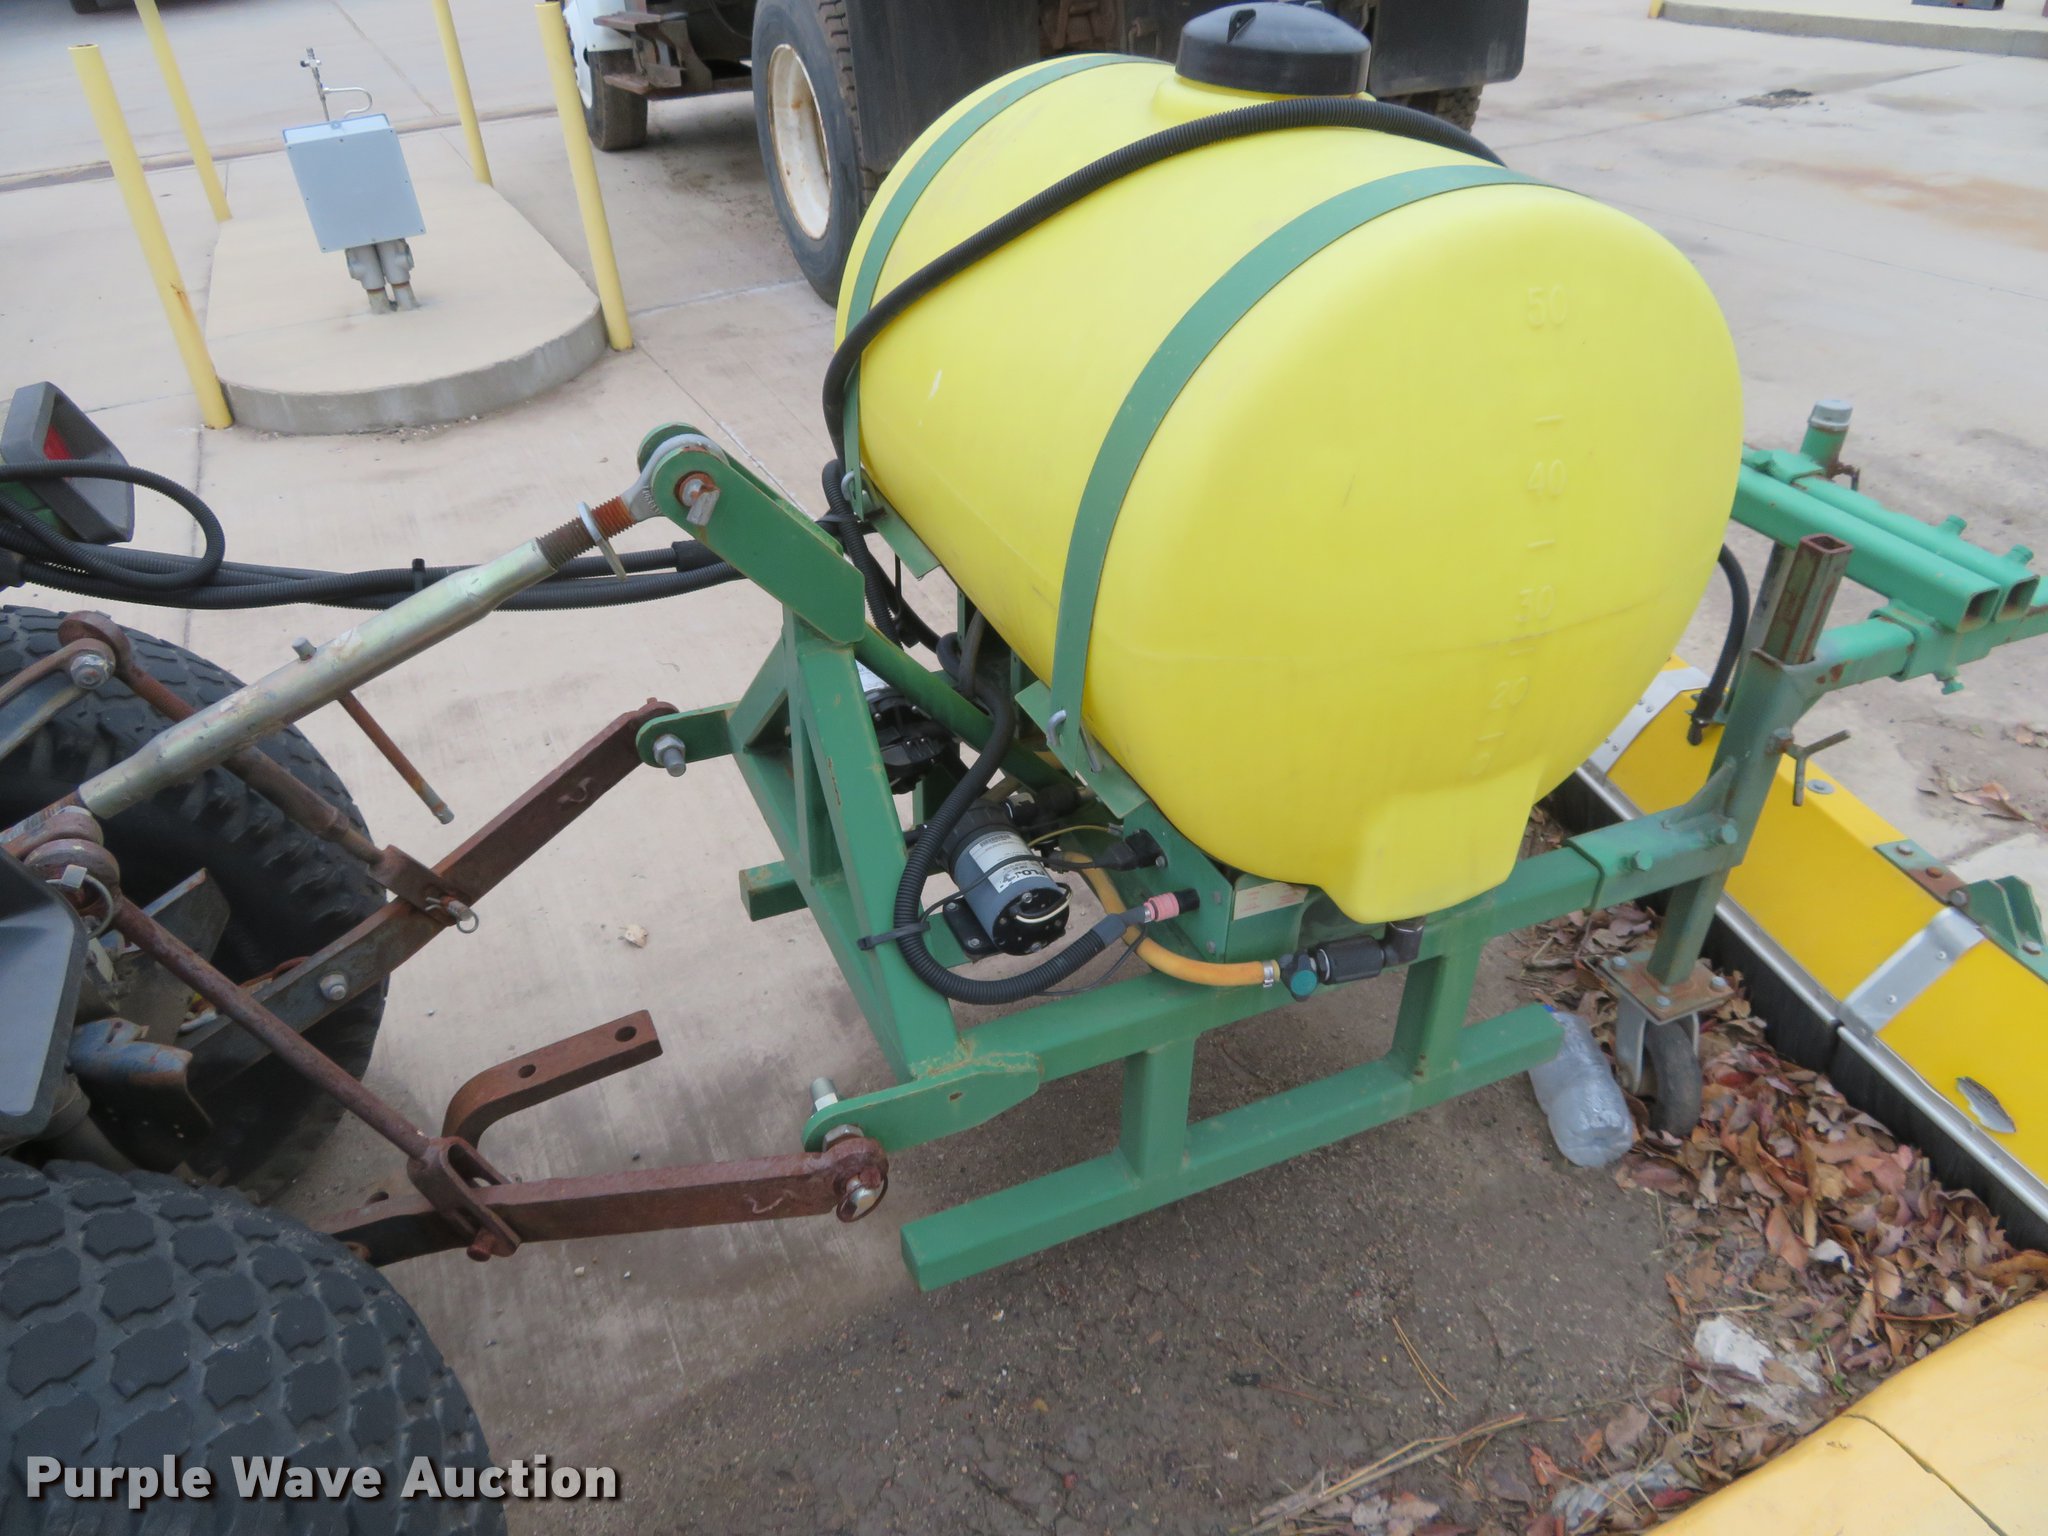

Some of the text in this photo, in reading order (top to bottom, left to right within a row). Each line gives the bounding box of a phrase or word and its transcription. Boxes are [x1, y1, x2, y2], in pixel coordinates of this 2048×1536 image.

[1527, 284, 1568, 327] 50
[1527, 459, 1567, 497] 40
[1515, 585, 1554, 621] 30
